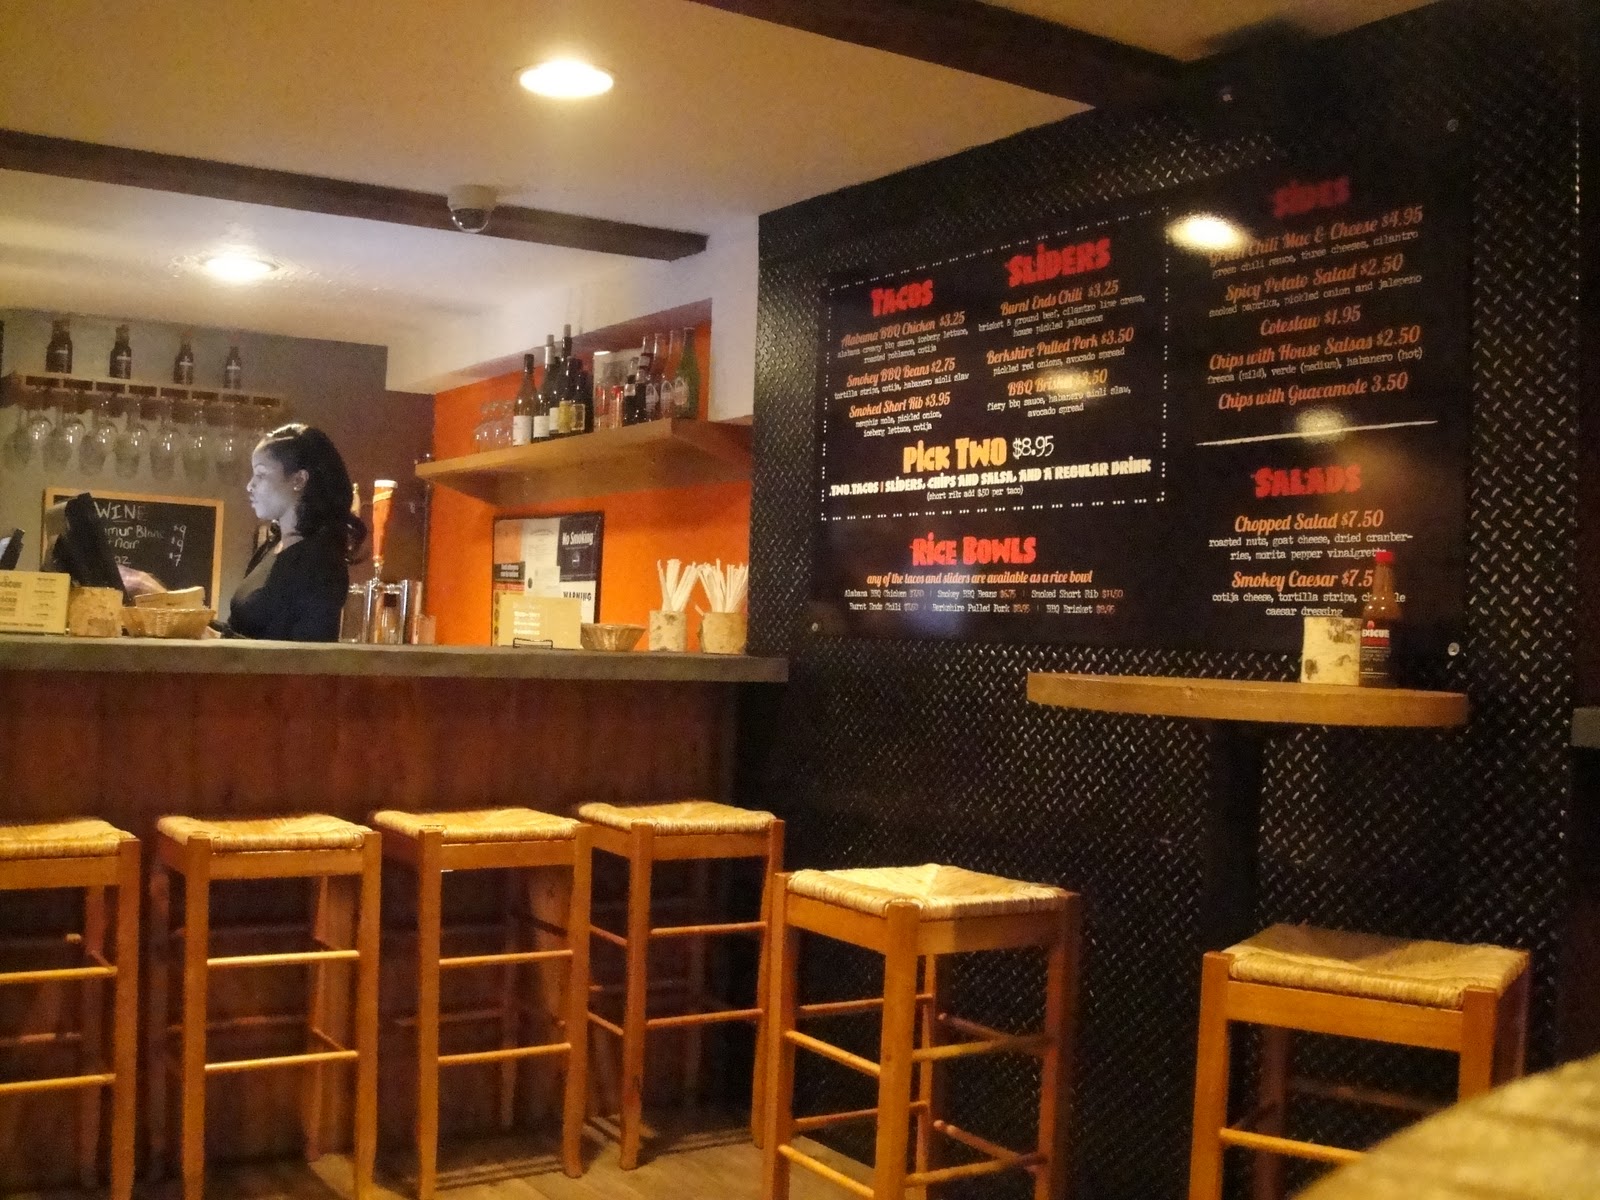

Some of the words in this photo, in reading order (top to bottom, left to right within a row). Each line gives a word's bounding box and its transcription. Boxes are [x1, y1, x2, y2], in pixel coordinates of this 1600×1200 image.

[1330, 218, 1377, 241] Cheese
[1382, 206, 1423, 228] $4.95
[1374, 230, 1419, 246] cilantro
[1225, 283, 1261, 305] Spicy
[1265, 275, 1308, 295] Potato
[1313, 264, 1356, 286] Salad
[1360, 253, 1404, 276] $2.50
[871, 279, 934, 317] TACOS
[1000, 300, 1029, 316] Burnt
[1032, 294, 1057, 309] Ends
[1058, 287, 1083, 305] Chili
[1088, 279, 1119, 298] $3.25
[1242, 300, 1280, 314] paprika,
[1323, 287, 1350, 299] onion
[1356, 282, 1373, 293] and
[979, 321, 1004, 332] brisket
[1015, 314, 1039, 327] ground
[1043, 310, 1060, 320] beef,
[1063, 304, 1096, 317] cilantro
[1100, 300, 1117, 310] lime
[1013, 324, 1033, 338] house
[1036, 320, 1063, 335] pickled
[1066, 313, 1103, 329] jalapenos
[1260, 315, 1320, 336] Coleslaw
[1324, 304, 1361, 325] $1.95
[841, 330, 879, 349] Alabama
[879, 324, 901, 340] BBQ
[902, 320, 935, 336] Chicken
[940, 311, 965, 326] $3.25
[918, 332, 940, 345] iceberg
[943, 328, 968, 339] lettuce,
[864, 353, 886, 364] roasted
[918, 344, 937, 354] cotija
[987, 346, 1035, 365] Berkshire
[1037, 338, 1070, 356] Pulled
[1072, 335, 1098, 351] Pork
[1101, 327, 1135, 345] $3.50
[1210, 354, 1244, 372] Chips
[1247, 348, 1275, 365] with
[1279, 343, 1321, 361] House
[1324, 337, 1373, 355] Salsas
[1376, 325, 1421, 346] $2.50
[847, 373, 879, 388] Smokey
[881, 367, 902, 383] BBQ
[903, 364, 930, 378] Beans
[931, 357, 956, 373] $2.75
[993, 364, 1019, 377] pickled
[1022, 363, 1034, 371] red
[1037, 359, 1063, 369] onions,
[1066, 352, 1095, 364] avocado
[1099, 347, 1125, 360] spread
[1239, 367, 1267, 383] (mild),
[1271, 364, 1297, 376] verde
[1300, 359, 1342, 374] (medium),
[1347, 352, 1393, 368] habanero
[1398, 347, 1423, 361] (hot)
[834, 388, 858, 400] tortilla
[860, 386, 880, 396] strips,
[882, 383, 902, 393] cotija,
[904, 379, 932, 390] habanero
[935, 376, 951, 385] aioli
[954, 373, 969, 382] slaw
[987, 400, 1006, 412] fiery
[1009, 399, 1021, 409] bbq
[1024, 396, 1045, 407] sauce,
[1049, 391, 1083, 403] habanero
[1111, 385, 1131, 395] slaw,
[1008, 380, 1033, 397] BBQ
[1219, 392, 1254, 412] Chips
[1256, 388, 1285, 406] with
[1288, 378, 1368, 407] Guacamole
[1371, 372, 1409, 393] 3.50
[849, 401, 882, 419] Smoked
[883, 398, 906, 414] Short
[909, 396, 923, 411] Rib
[925, 392, 951, 407] $3.95
[898, 412, 920, 424] pickled
[923, 410, 942, 420] onion,
[1028, 408, 1056, 417] avocado
[1059, 403, 1084, 416] spread
[864, 428, 885, 438] iceberg
[888, 426, 911, 435] lettuce,
[913, 422, 932, 433] cotija
[955, 437, 1007, 470] TWO
[1013, 435, 1054, 460] $8.95
[958, 474, 979, 487] AND
[1019, 468, 1042, 483] AND
[1055, 463, 1109, 479] REGULAR
[1251, 464, 1361, 498] SALADS
[927, 491, 946, 502] (short
[964, 489, 975, 498] add
[992, 489, 1004, 497] per
[1007, 485, 1023, 495] taco)
[94, 501, 148, 521] WINE
[1235, 514, 1291, 537] Chopped
[1295, 513, 1338, 530] Salad
[1341, 510, 1384, 528] $7.50
[562, 533, 570, 545] No
[570, 531, 593, 546] Smoking
[963, 536, 1037, 566] BOWLS
[1209, 538, 1242, 548] roasted
[1246, 537, 1269, 547] nuts,
[1273, 536, 1293, 547] goat
[1298, 535, 1330, 545] cheese,
[1334, 533, 1361, 544] dried
[1366, 532, 1414, 543] cranber-
[1230, 551, 1252, 562] ries,
[1256, 550, 1287, 560] morita
[1291, 550, 1323, 561] pepper
[867, 574, 882, 588] any
[883, 572, 892, 587] of
[892, 573, 903, 584] the
[905, 574, 925, 584] tacos
[926, 574, 942, 584] and
[943, 573, 970, 584] sliders
[971, 575, 985, 584] are
[987, 571, 1028, 584] available
[1030, 574, 1041, 584] as
[1042, 574, 1050, 583] a
[1050, 571, 1068, 583] rice
[1070, 570, 1093, 584] bowl
[1232, 571, 1285, 593] Smokey
[1289, 571, 1338, 588] Caesar
[563, 592, 592, 601] WARNING
[844, 589, 868, 598] Alabama
[884, 590, 907, 598] Chicken
[937, 590, 960, 600] Smokey
[978, 590, 997, 598] Beans
[1031, 590, 1056, 599] Smoked
[1059, 590, 1081, 599] Short
[1085, 590, 1099, 599] Rib
[1212, 593, 1239, 604] cotija
[1243, 594, 1274, 604] cheese,
[1278, 592, 1319, 602] tortilla
[1323, 593, 1358, 604] strips,
[849, 602, 867, 611] Burnt
[869, 603, 883, 611] Ends
[885, 602, 902, 611] Chili
[932, 603, 965, 613] Berkshire
[968, 603, 990, 612] Pulled
[994, 604, 1010, 613] Pork
[1063, 604, 1093, 614] Brisket
[1266, 607, 1297, 616] caesar
[1301, 607, 1343, 618] dressing
